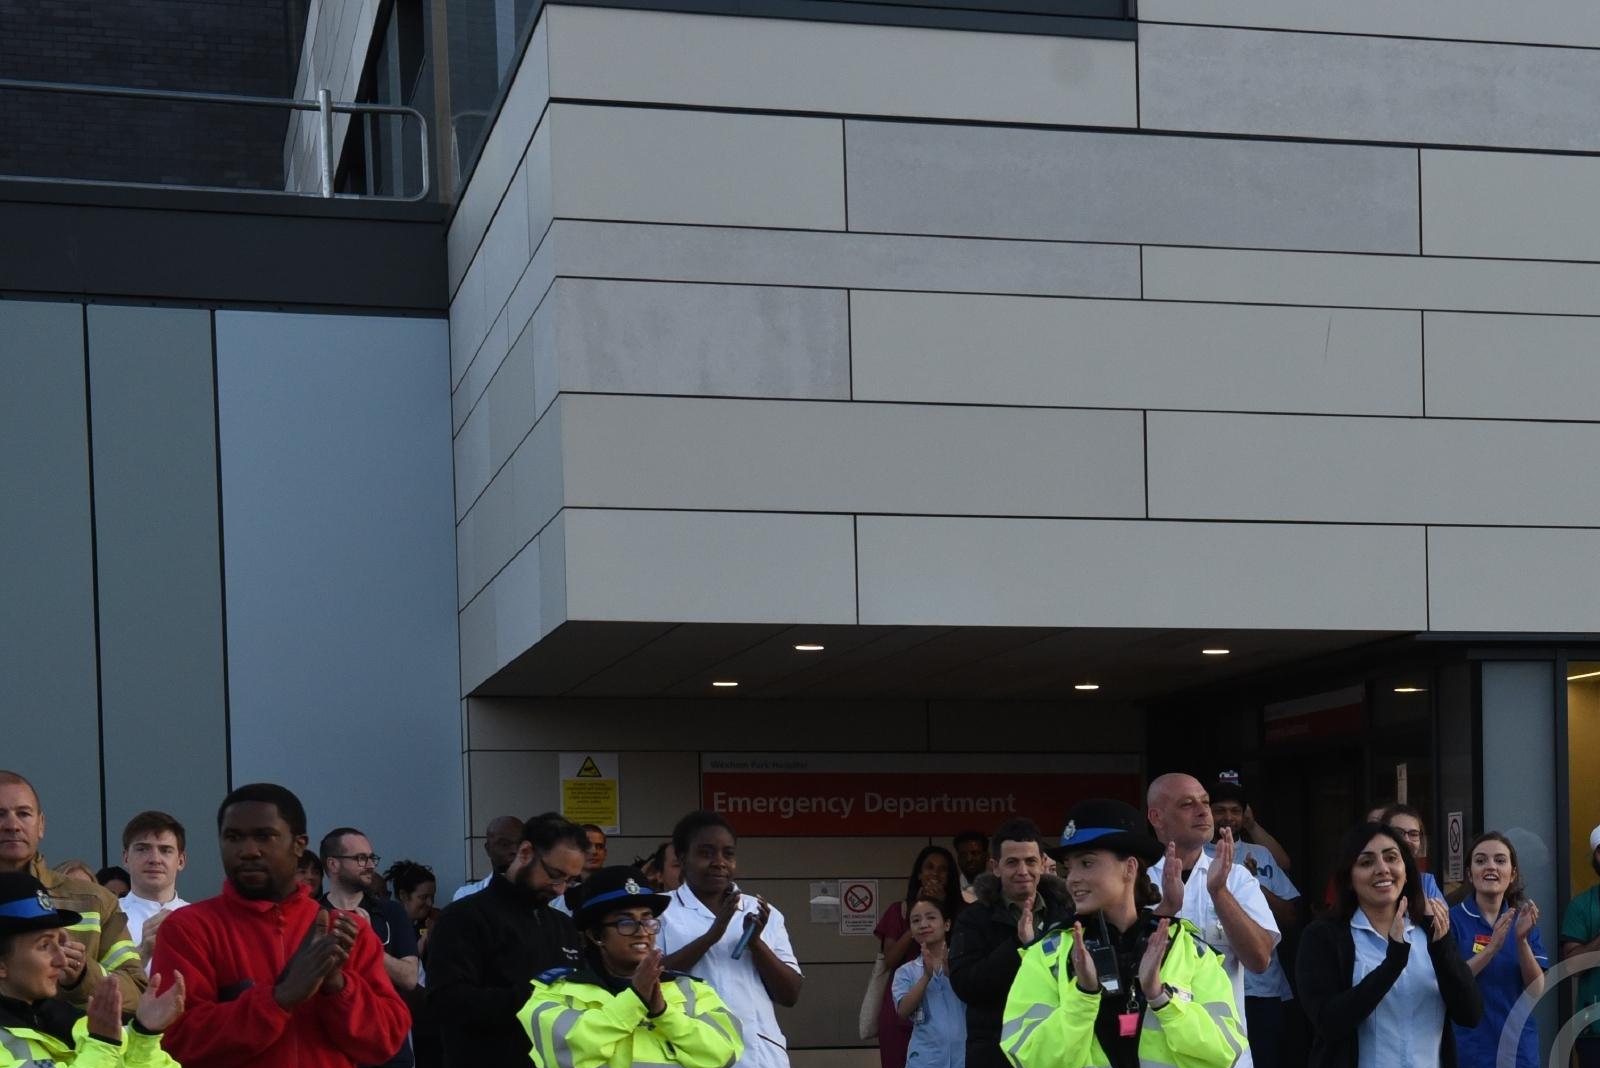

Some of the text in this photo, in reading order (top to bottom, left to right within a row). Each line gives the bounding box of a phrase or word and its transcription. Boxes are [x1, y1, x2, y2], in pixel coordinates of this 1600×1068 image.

[751, 759, 769, 769] Park
[713, 791, 1017, 819] Emergency Department
